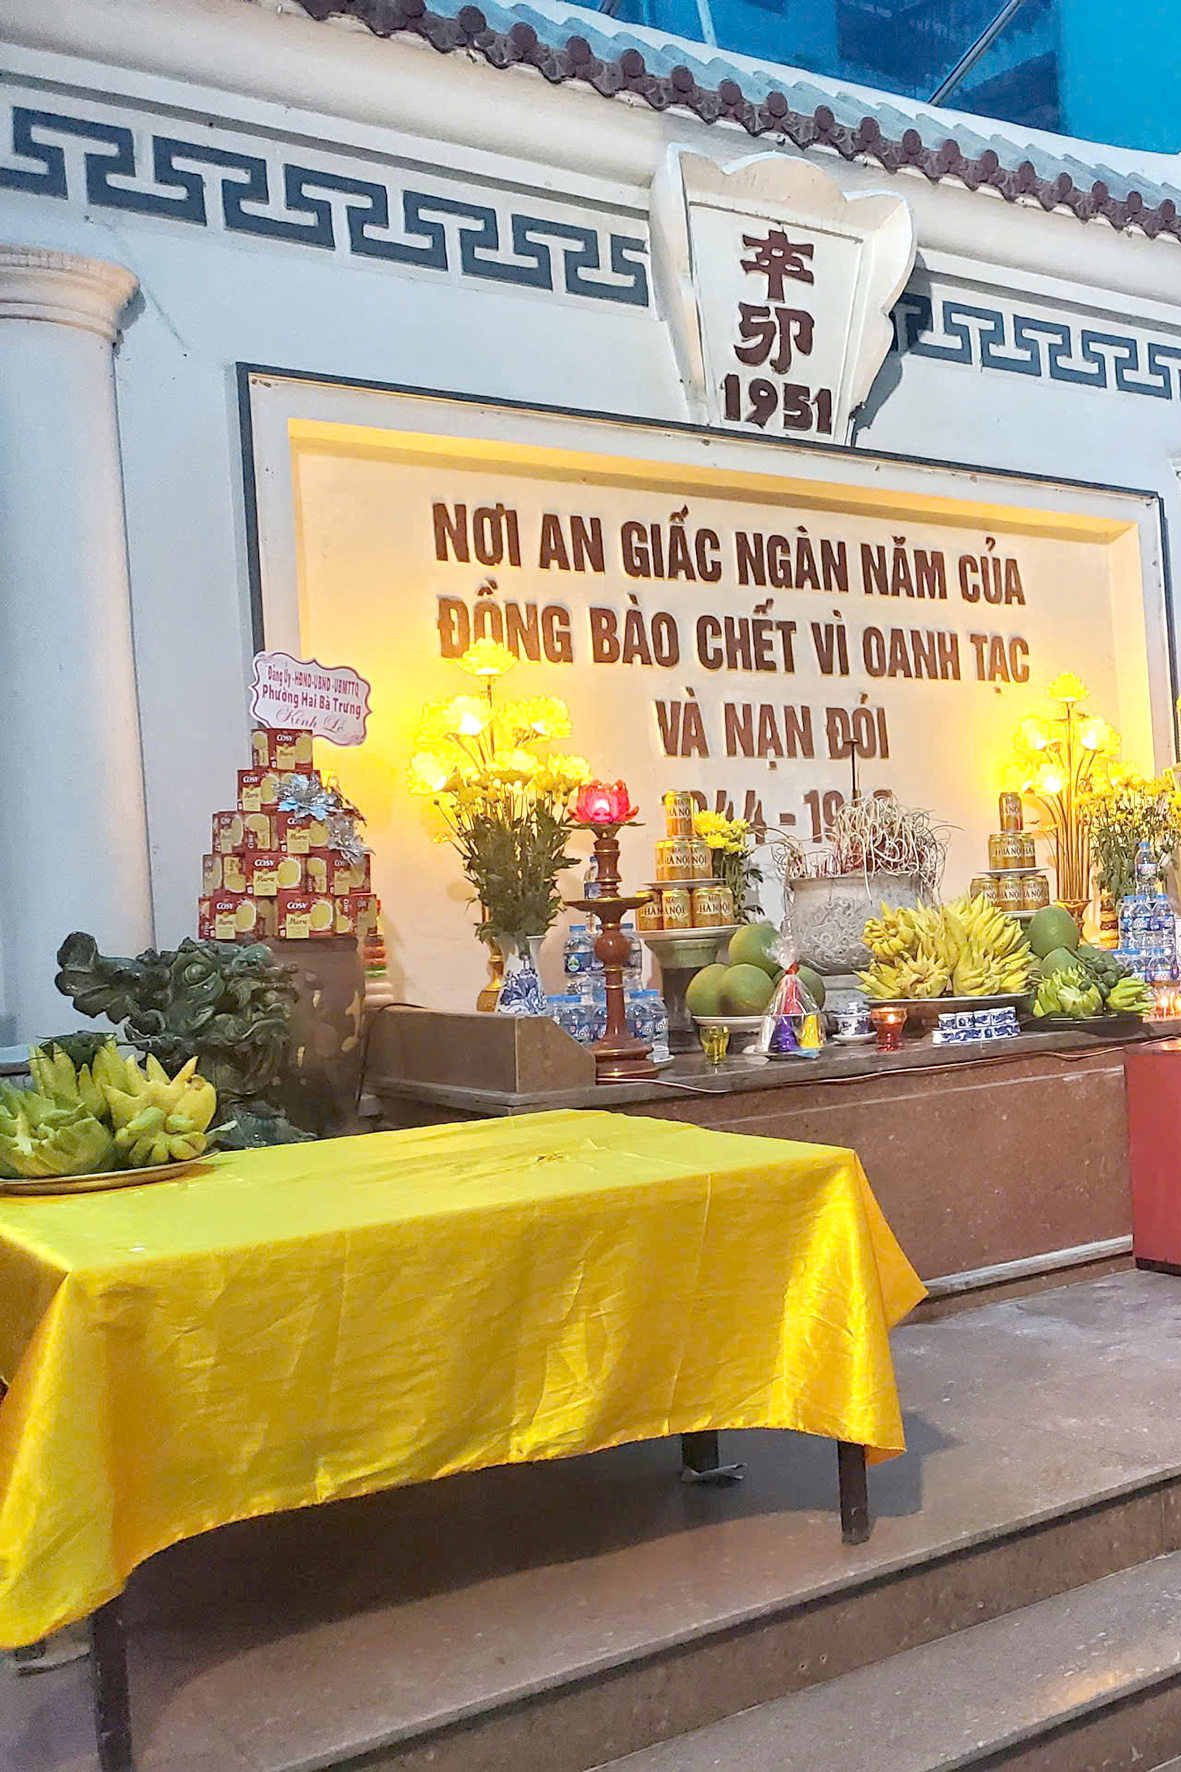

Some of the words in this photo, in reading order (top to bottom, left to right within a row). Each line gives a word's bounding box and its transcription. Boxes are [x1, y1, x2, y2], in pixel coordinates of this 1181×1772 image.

[724, 373, 832, 435] 1951
[432, 502, 520, 568] NƠI
[538, 513, 605, 574] AN
[620, 505, 724, 583] GIẤC
[735, 524, 850, 593] NGÀN
[860, 535, 948, 600] NĂM
[958, 535, 1027, 607] CỦA
[437, 577, 574, 664] ĐỒNG
[589, 593, 680, 668] BÀO
[695, 598, 798, 674] CHẾT
[811, 608, 851, 678] VÌ
[862, 624, 961, 681] OANH
[968, 632, 1031, 694] TẠC
[262, 684, 299, 709] Phường
[301, 691, 317, 709] Hai
[319, 694, 330, 711] Bà
[333, 697, 362, 720] Trưng
[275, 706, 318, 729] Kính
[653, 687, 709, 759] VÀ
[724, 701, 816, 770] NẠN
[824, 693, 890, 760] ĐÓI
[662, 789, 766, 845] 44
[286, 901, 308, 910] COSY
